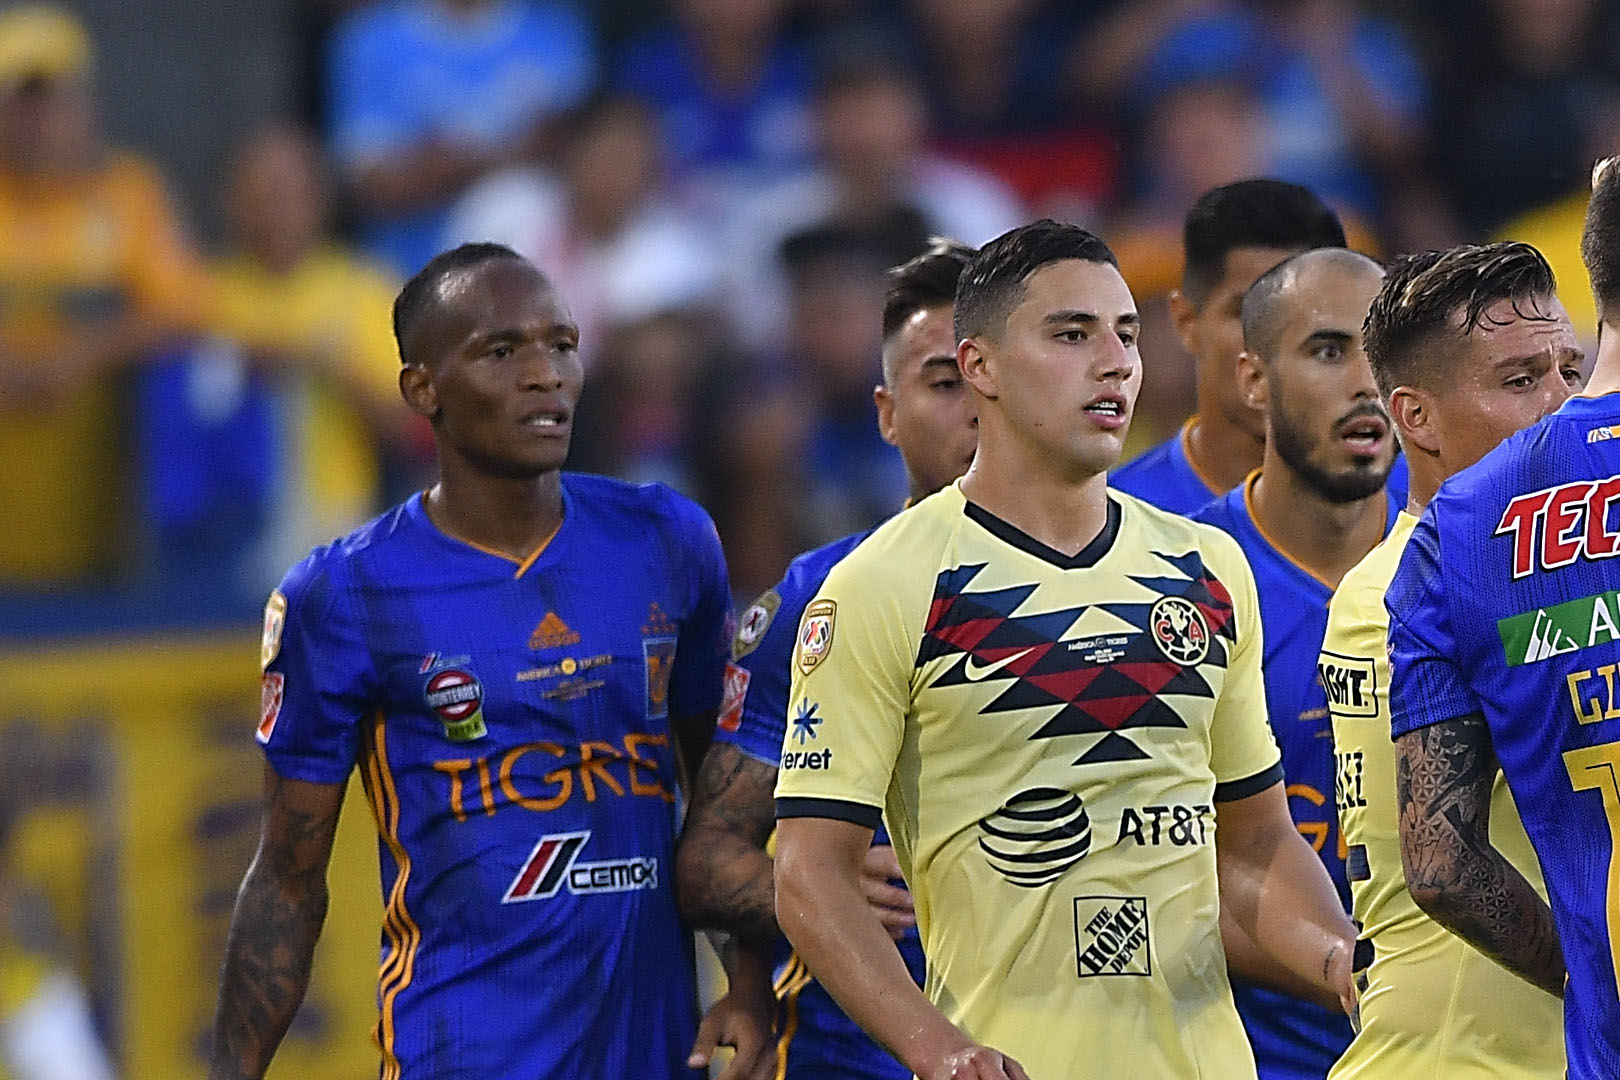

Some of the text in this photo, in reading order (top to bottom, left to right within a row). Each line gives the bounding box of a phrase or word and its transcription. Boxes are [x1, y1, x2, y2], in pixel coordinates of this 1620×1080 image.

[433, 733, 676, 822] TIGRE
[1116, 805, 1211, 845] AT&T
[1080, 899, 1145, 973] HOME
[1084, 906, 1112, 937] THE
[1110, 927, 1147, 973] DEPOT
